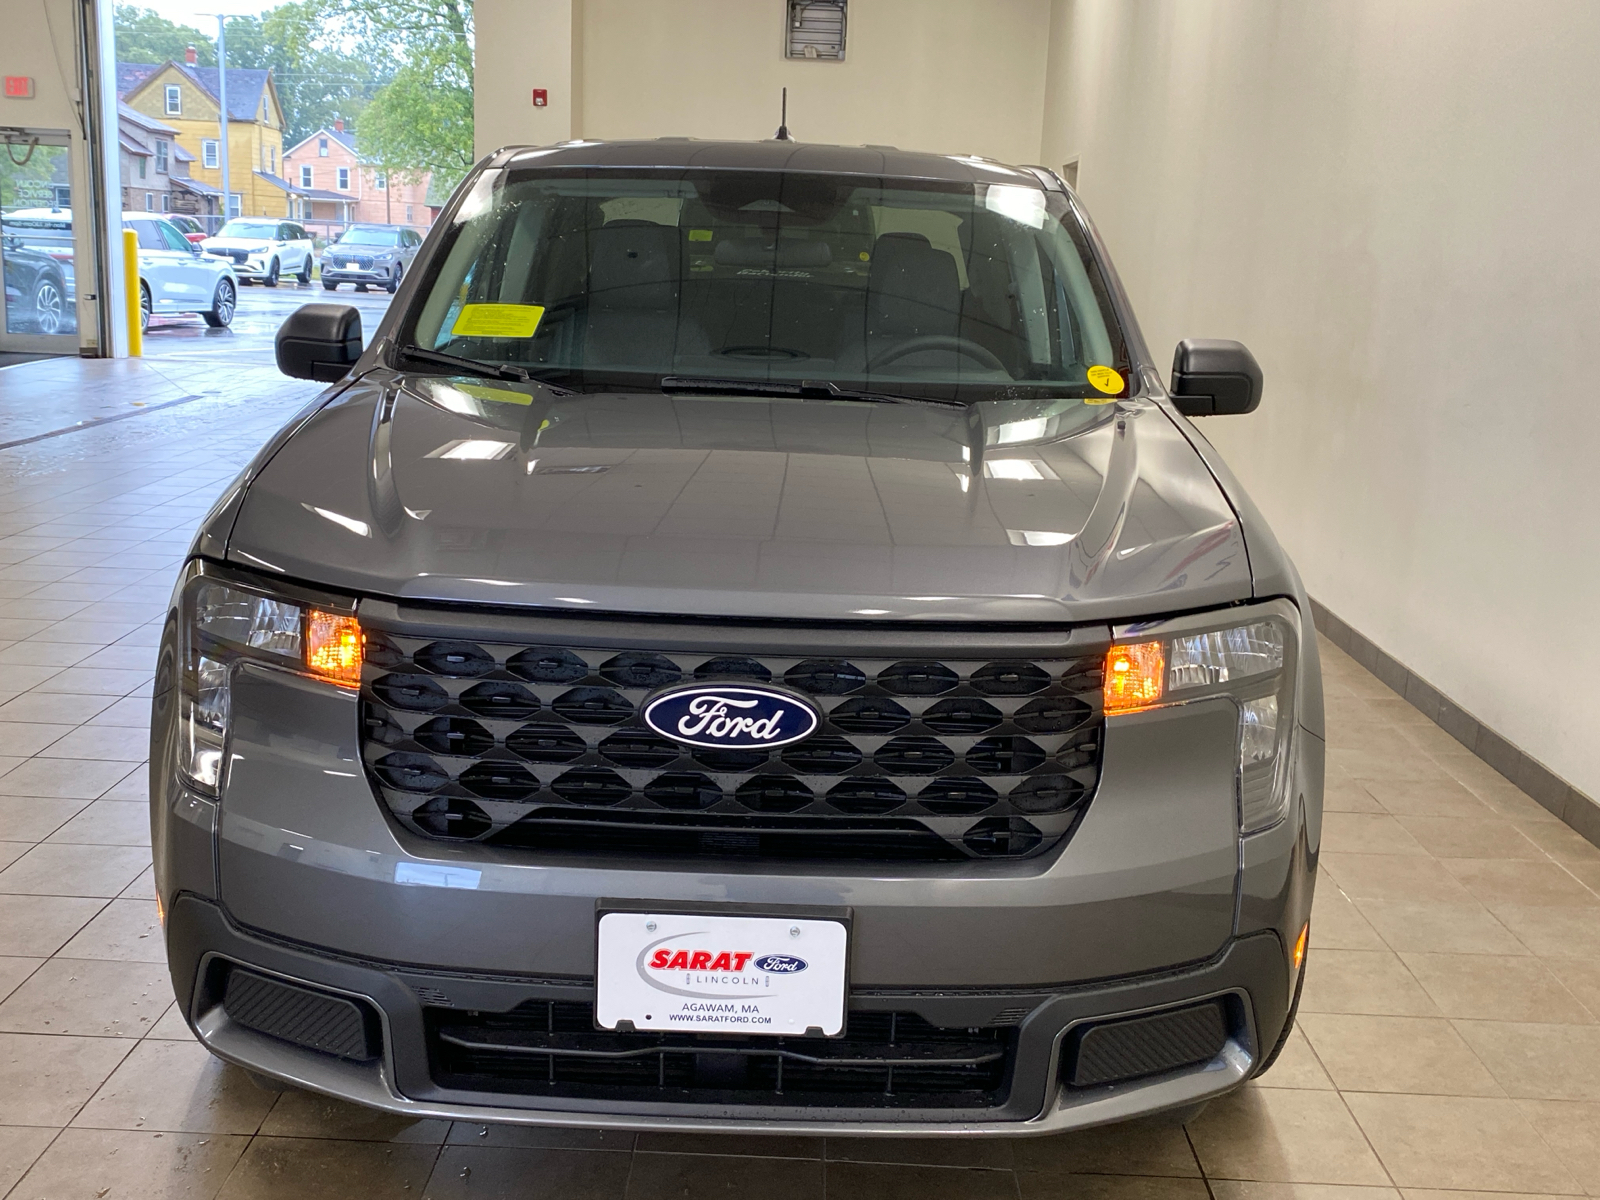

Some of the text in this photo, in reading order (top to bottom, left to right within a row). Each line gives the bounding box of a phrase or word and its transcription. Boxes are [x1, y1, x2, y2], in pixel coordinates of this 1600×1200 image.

[677, 695, 785, 739] Ford
[648, 948, 798, 972] SARAT Ford
[696, 975, 760, 985] LINCOLN
[681, 1002, 760, 1014] AGAWAM, MA
[668, 1013, 772, 1024] WWW.SARATFORD.COM
